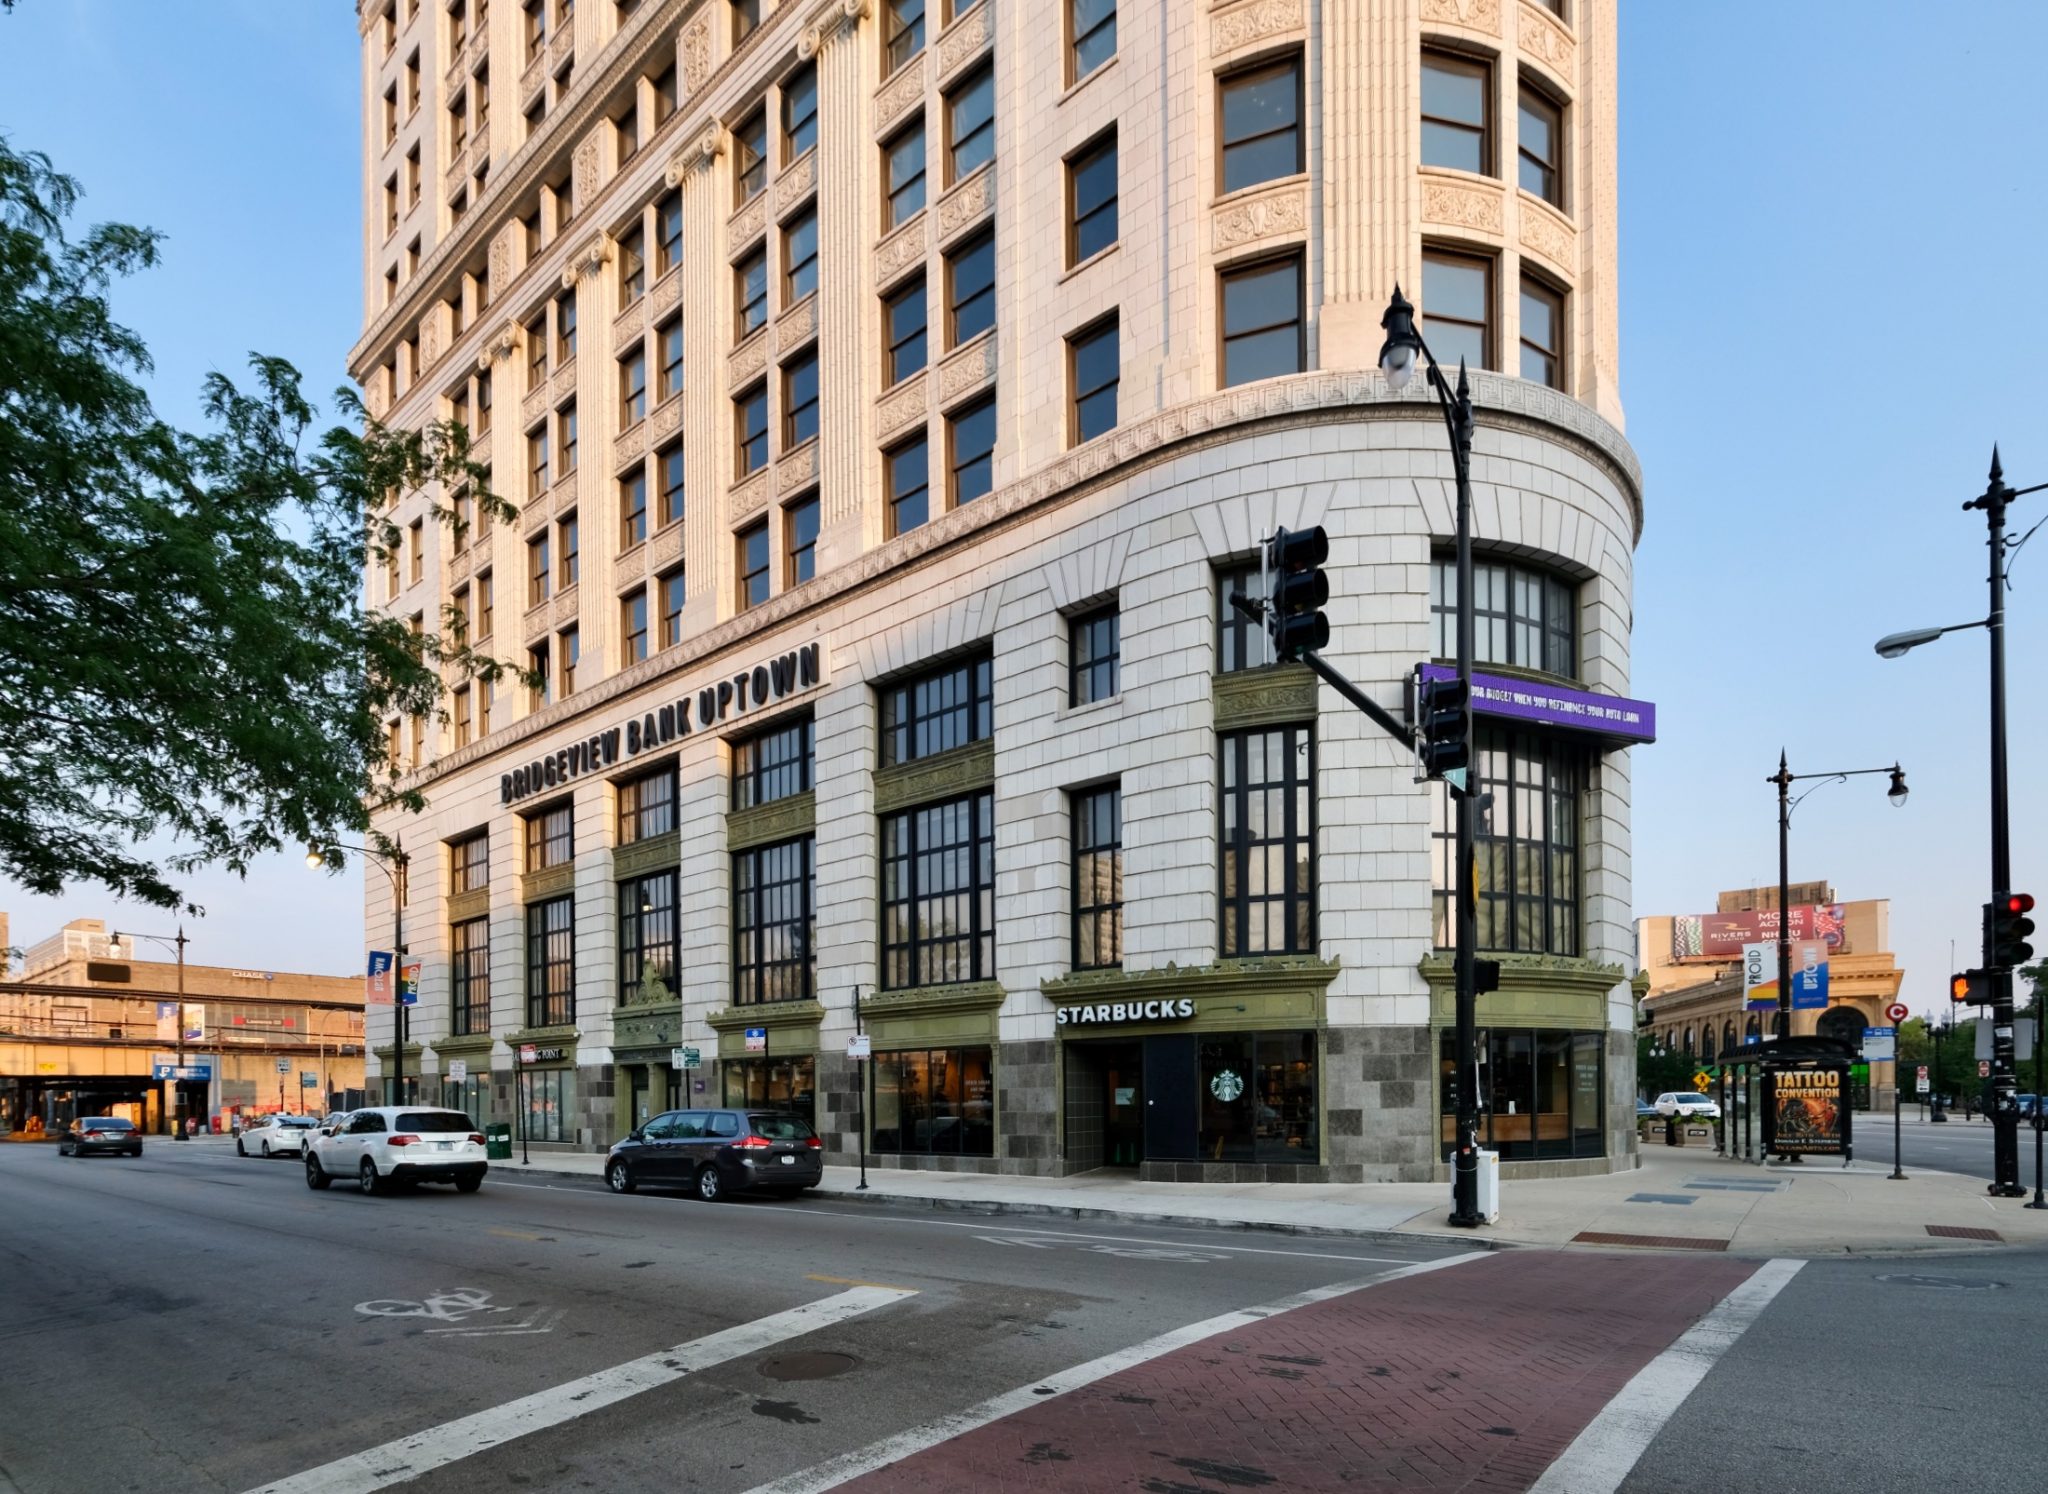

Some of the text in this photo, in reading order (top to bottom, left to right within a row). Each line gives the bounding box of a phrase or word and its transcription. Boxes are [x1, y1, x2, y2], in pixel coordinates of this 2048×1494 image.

[1533, 696, 1547, 708] YOU
[501, 642, 821, 804] BRIDGEVIEW BANK UPTOWN
[1758, 919, 1804, 928] ACTON
[1710, 931, 1752, 939] RIVERS
[1748, 949, 1762, 985] PROUD
[407, 966, 419, 995] PROUD
[1056, 998, 1195, 1025] STARBUCKS
[1774, 1070, 1839, 1088] TATTOO
[1775, 1088, 1840, 1098] CONVENTION
